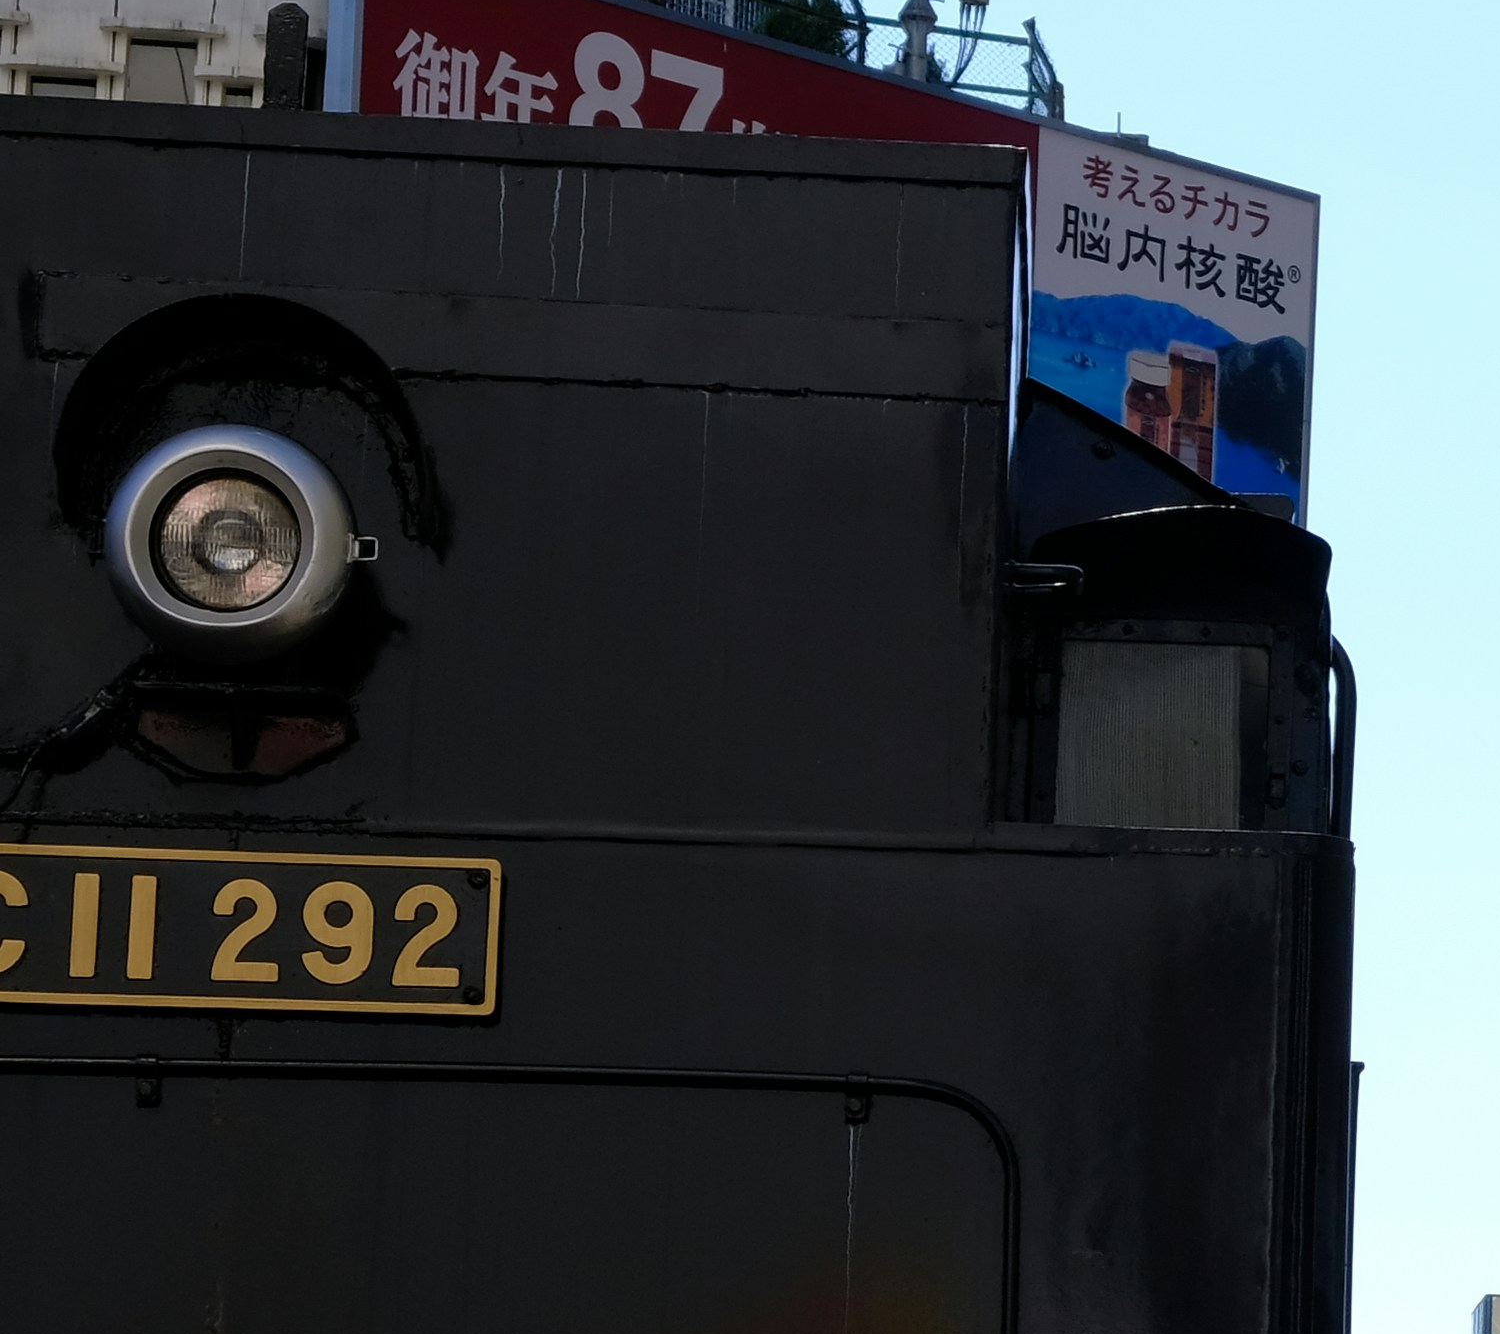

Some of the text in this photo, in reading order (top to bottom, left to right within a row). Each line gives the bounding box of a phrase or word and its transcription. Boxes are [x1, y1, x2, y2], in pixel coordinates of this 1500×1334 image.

[1080, 153, 1273, 240] 考えるチカラ
[209, 878, 461, 988] 292
